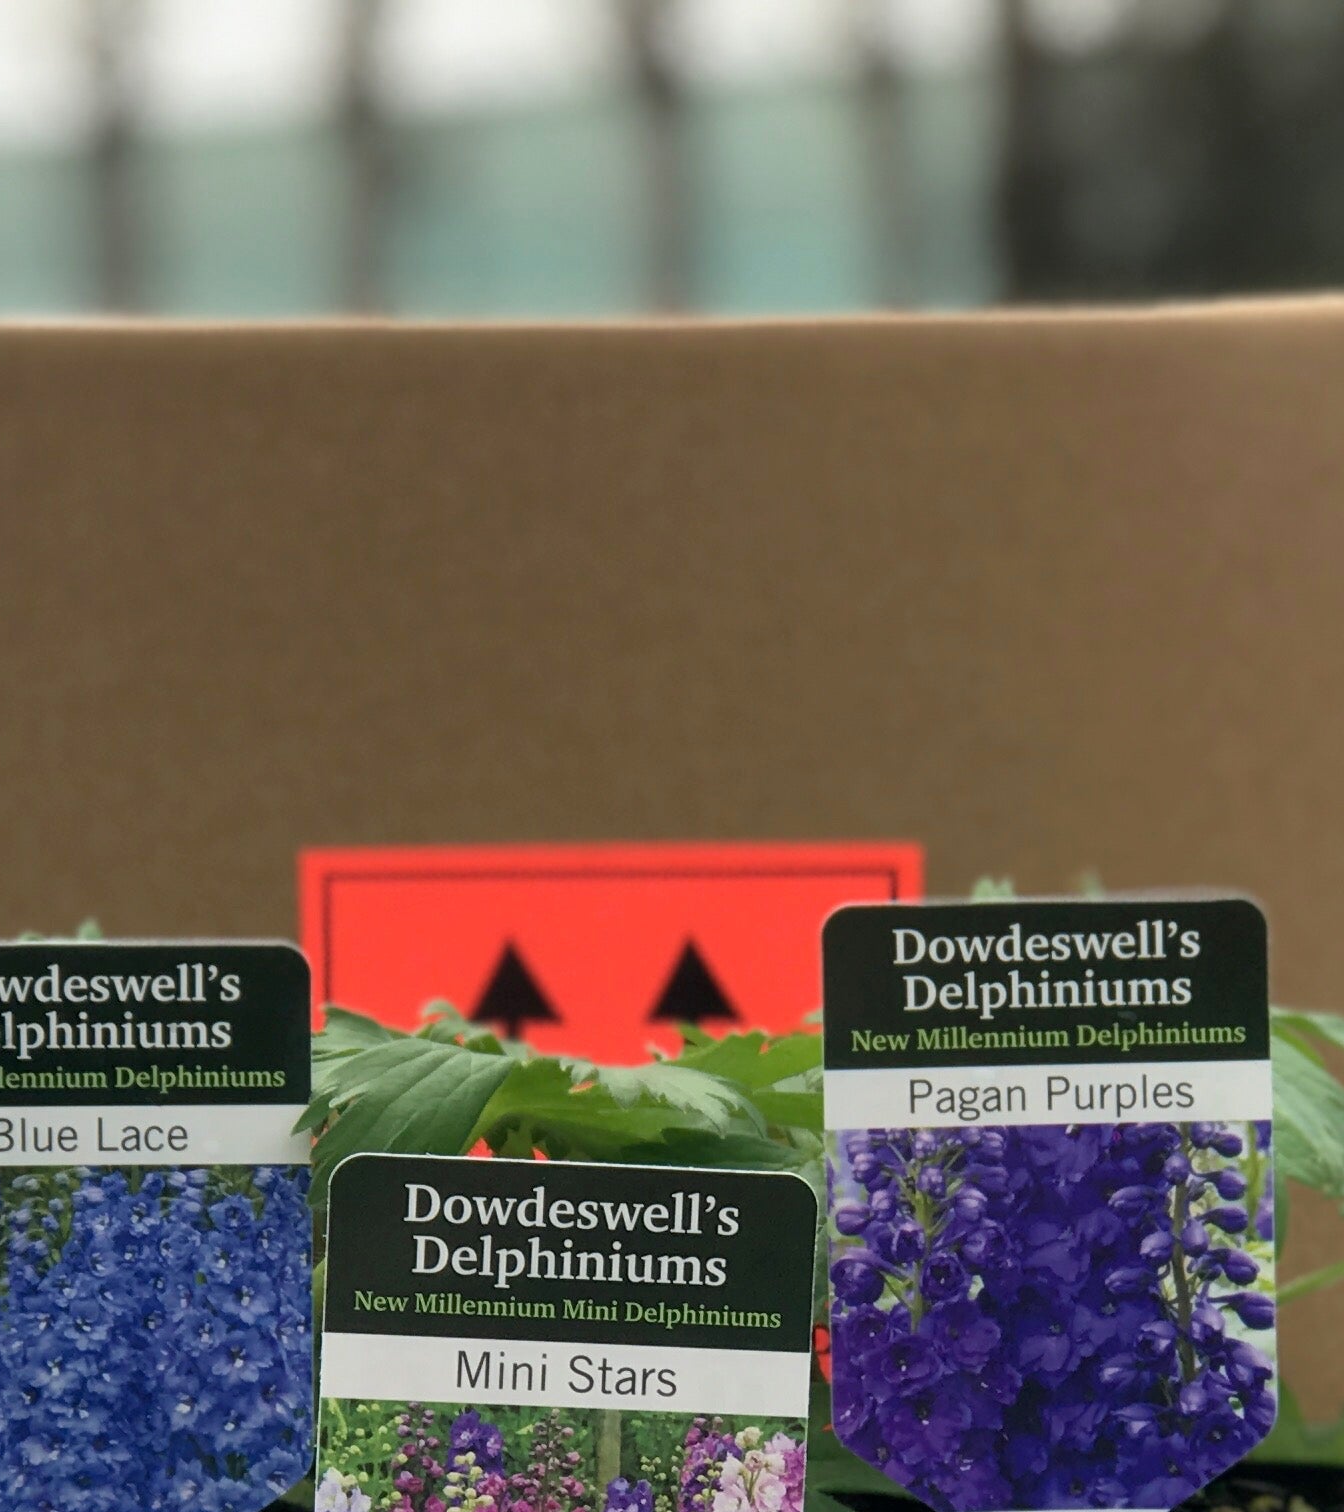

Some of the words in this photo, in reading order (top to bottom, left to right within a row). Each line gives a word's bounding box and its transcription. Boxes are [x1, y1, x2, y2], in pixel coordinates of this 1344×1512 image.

[892, 920, 1201, 965] Dowdeswell's
[903, 969, 1193, 1020] Delphiniums
[851, 1030, 910, 1053] New
[916, 1026, 1069, 1051] Millennium
[1076, 1023, 1247, 1053] Delphiniums
[114, 1065, 286, 1094] Delphiniums
[908, 1078, 1026, 1120] Pagan
[1046, 1074, 1195, 1117] Purples
[98, 1117, 189, 1152] Lace
[403, 1183, 740, 1236] Dowdeswell's
[411, 1234, 728, 1289] Delphiniums
[354, 1290, 409, 1314] New
[414, 1293, 556, 1320] Millennium
[562, 1299, 618, 1322] Mini
[623, 1302, 782, 1330] Delphiniums
[456, 1350, 548, 1392] Mini
[568, 1354, 677, 1398] Stars
